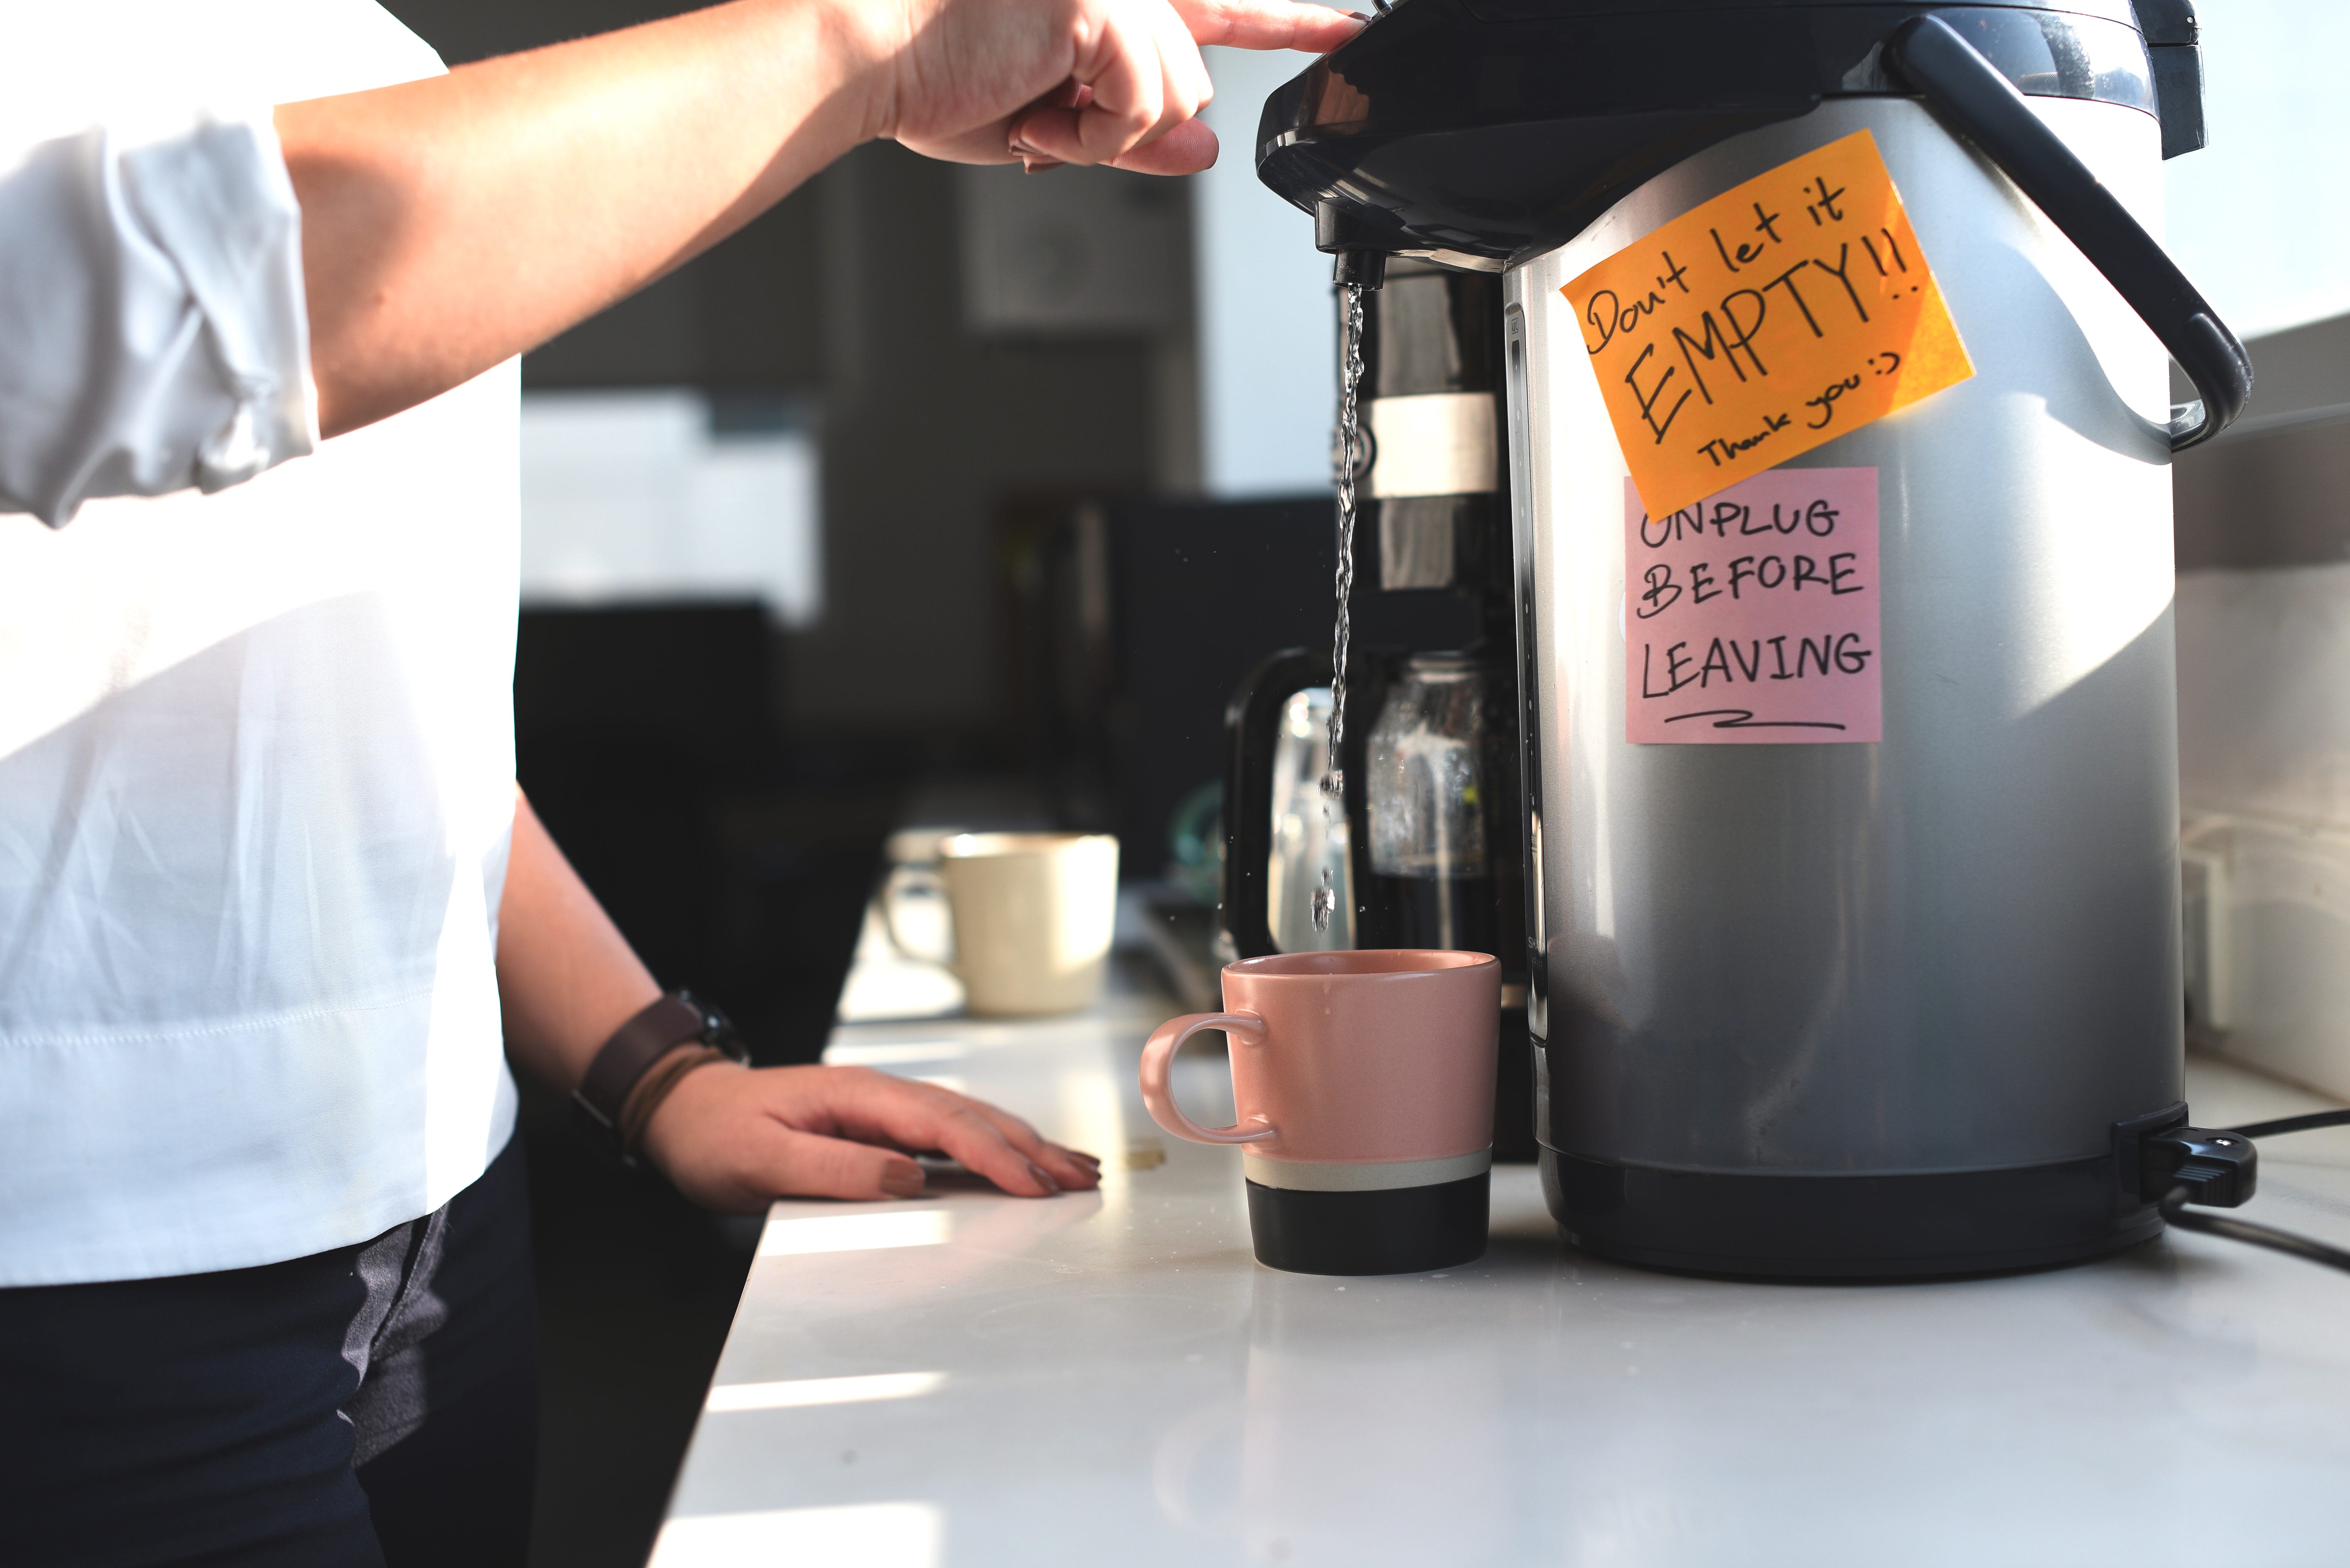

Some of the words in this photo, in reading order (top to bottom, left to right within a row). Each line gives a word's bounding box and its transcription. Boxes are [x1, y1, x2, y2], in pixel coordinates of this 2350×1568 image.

[1587, 251, 1689, 354] Don't
[1710, 202, 1782, 273] let
[1803, 177, 1845, 226] it
[1625, 228, 1919, 445] EMPTY!!
[1697, 413, 1791, 466] Thank
[1806, 374, 1861, 430] you
[1641, 499, 1840, 548] UNPLUG
[1636, 552, 1864, 619] BEFORE
[1642, 632, 1873, 699] LEAVING
